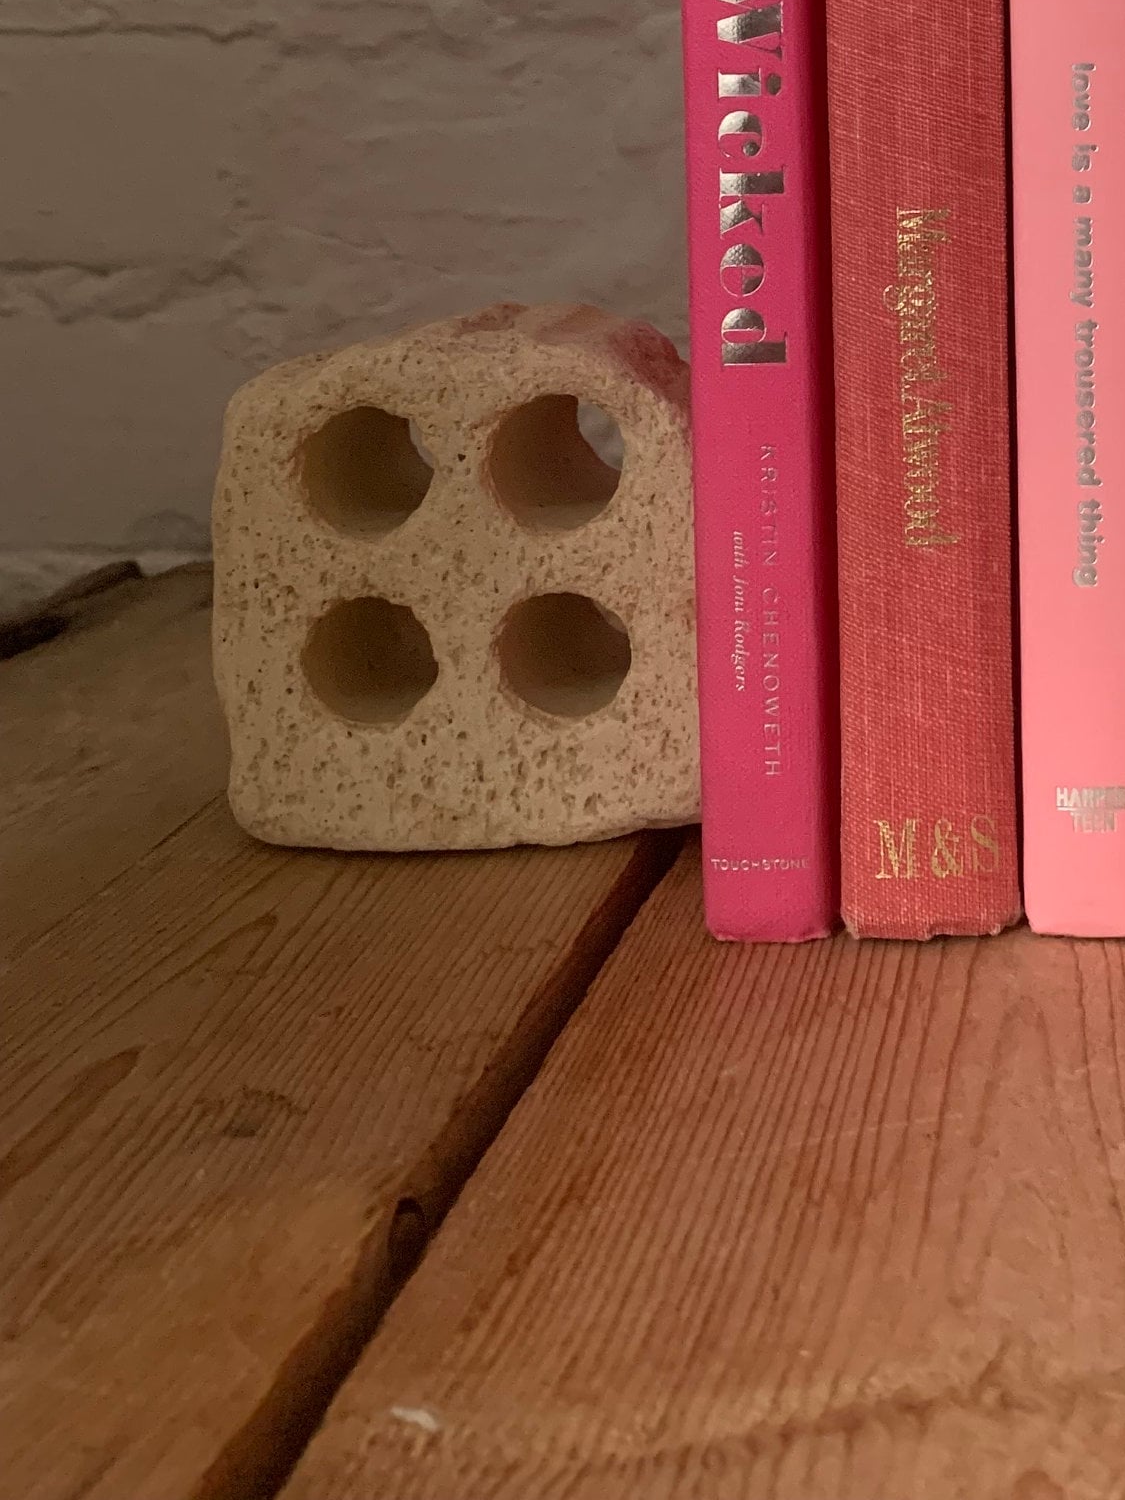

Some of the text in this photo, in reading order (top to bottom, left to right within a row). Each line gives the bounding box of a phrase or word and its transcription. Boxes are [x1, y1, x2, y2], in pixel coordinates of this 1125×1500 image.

[883, 205, 962, 550] Margaret Atwood
[1070, 62, 1105, 588] love is a many trousered thing
[730, 529, 752, 692] with Joni Rodgers
[759, 444, 783, 777] KRISTIN CHENOWETH
[710, 858, 810, 871] TOUCHSTONE
